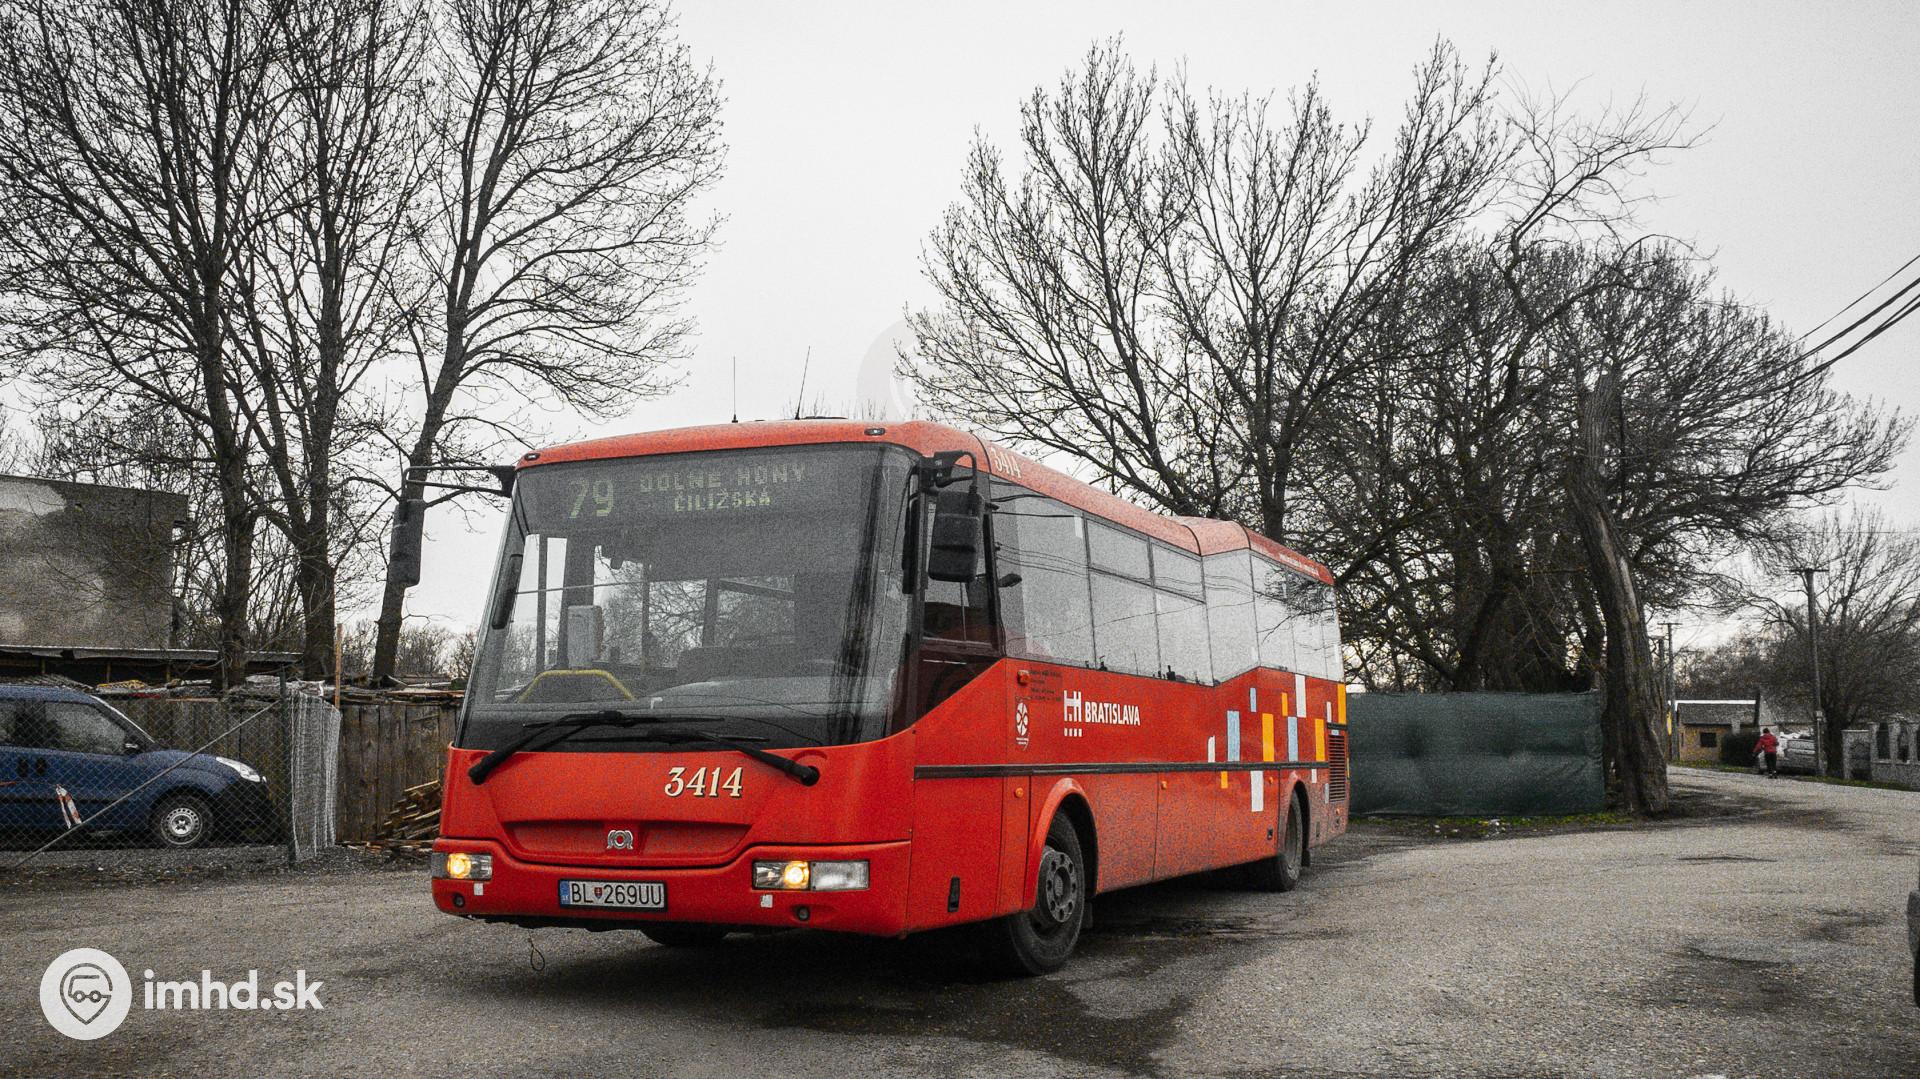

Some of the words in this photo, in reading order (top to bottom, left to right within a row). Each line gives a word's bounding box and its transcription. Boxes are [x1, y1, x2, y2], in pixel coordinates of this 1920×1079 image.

[737, 463, 806, 486] HONY
[990, 446, 1022, 479] 3414
[567, 477, 614, 518] 79
[1085, 701, 1140, 726] BRATISLAVA
[664, 766, 743, 797] 3414
[571, 883, 593, 903] BL
[603, 884, 661, 905] 269UU
